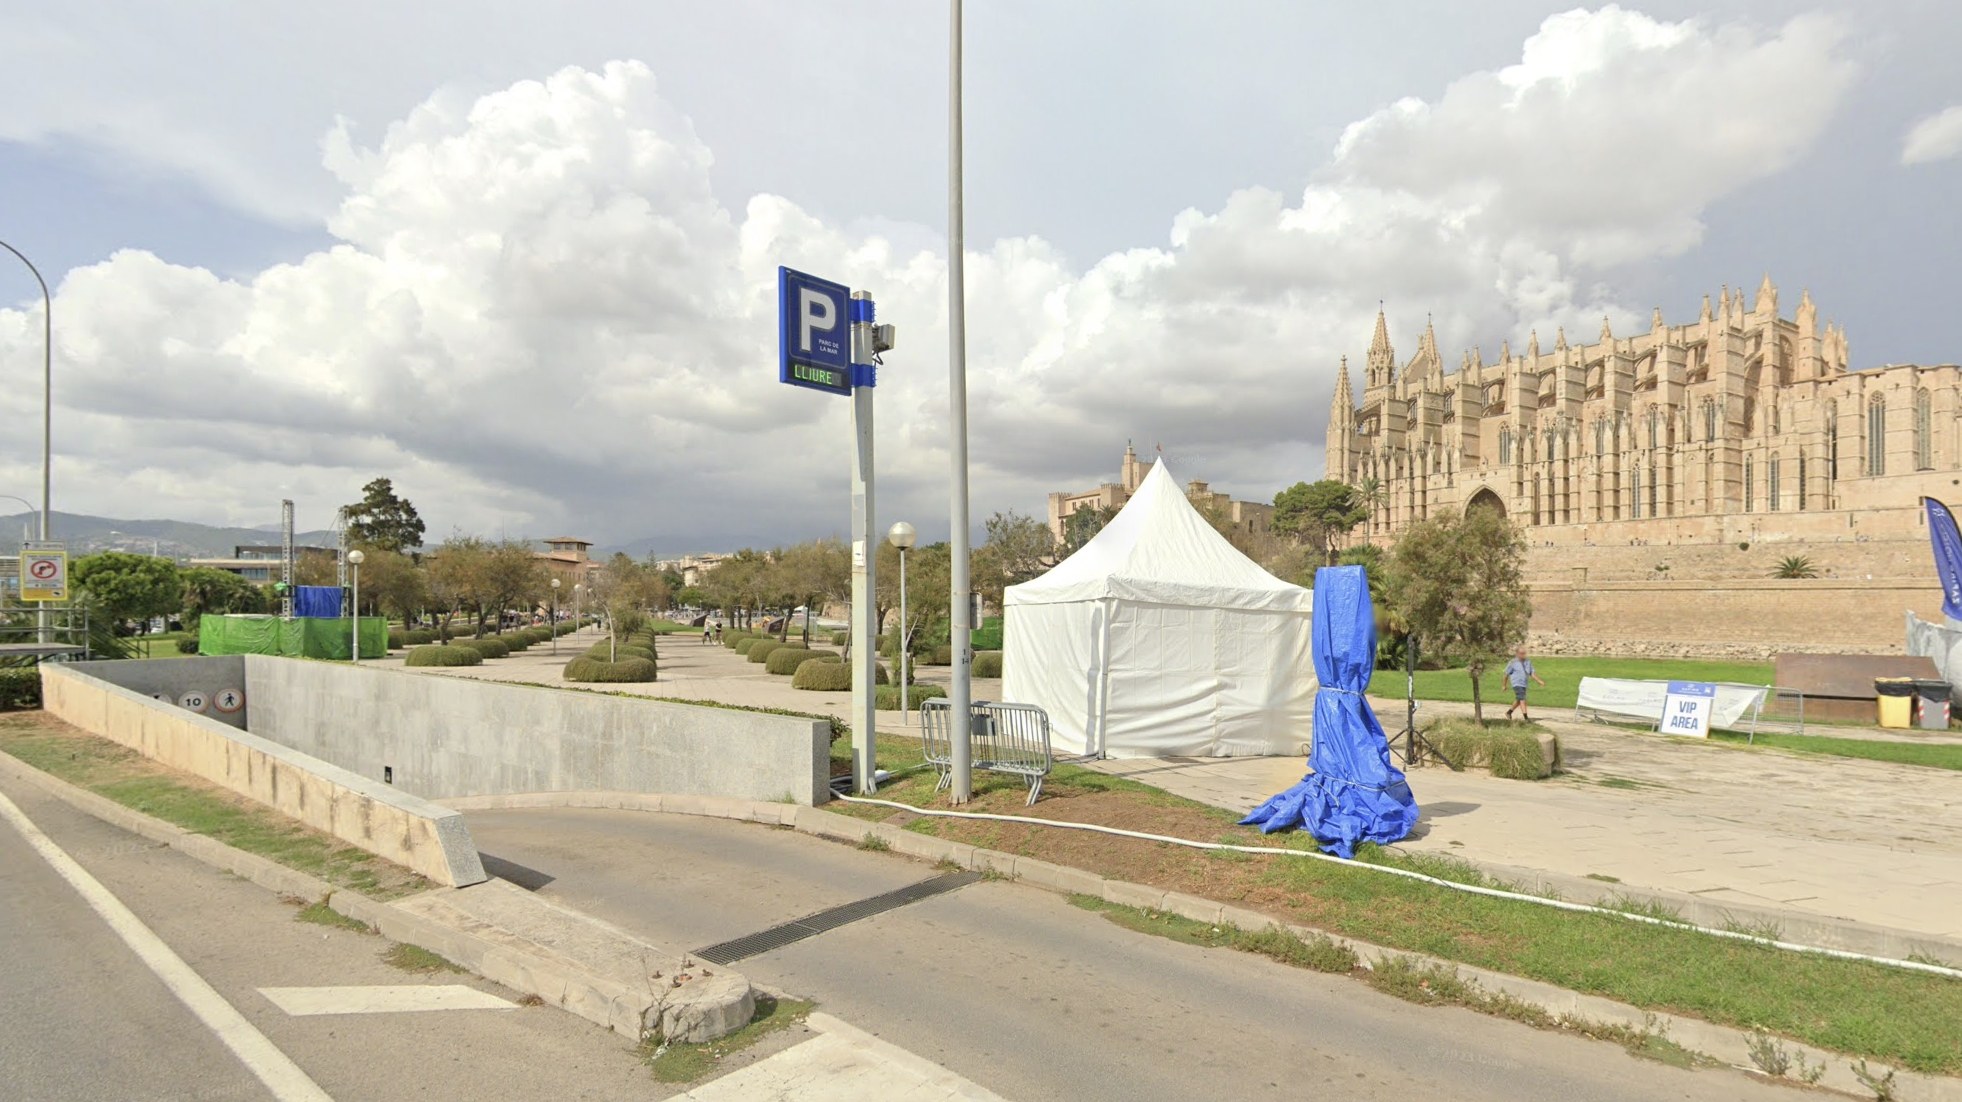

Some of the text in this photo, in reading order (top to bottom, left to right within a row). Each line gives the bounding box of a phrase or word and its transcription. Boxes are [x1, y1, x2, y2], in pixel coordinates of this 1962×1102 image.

[801, 288, 836, 352] P
[818, 339, 831, 347] PARC
[827, 347, 838, 355] MAR
[794, 366, 833, 385] LLIURE
[185, 698, 201, 706] 10
[1679, 701, 1697, 714] VIP
[1670, 715, 1698, 730] AREA
